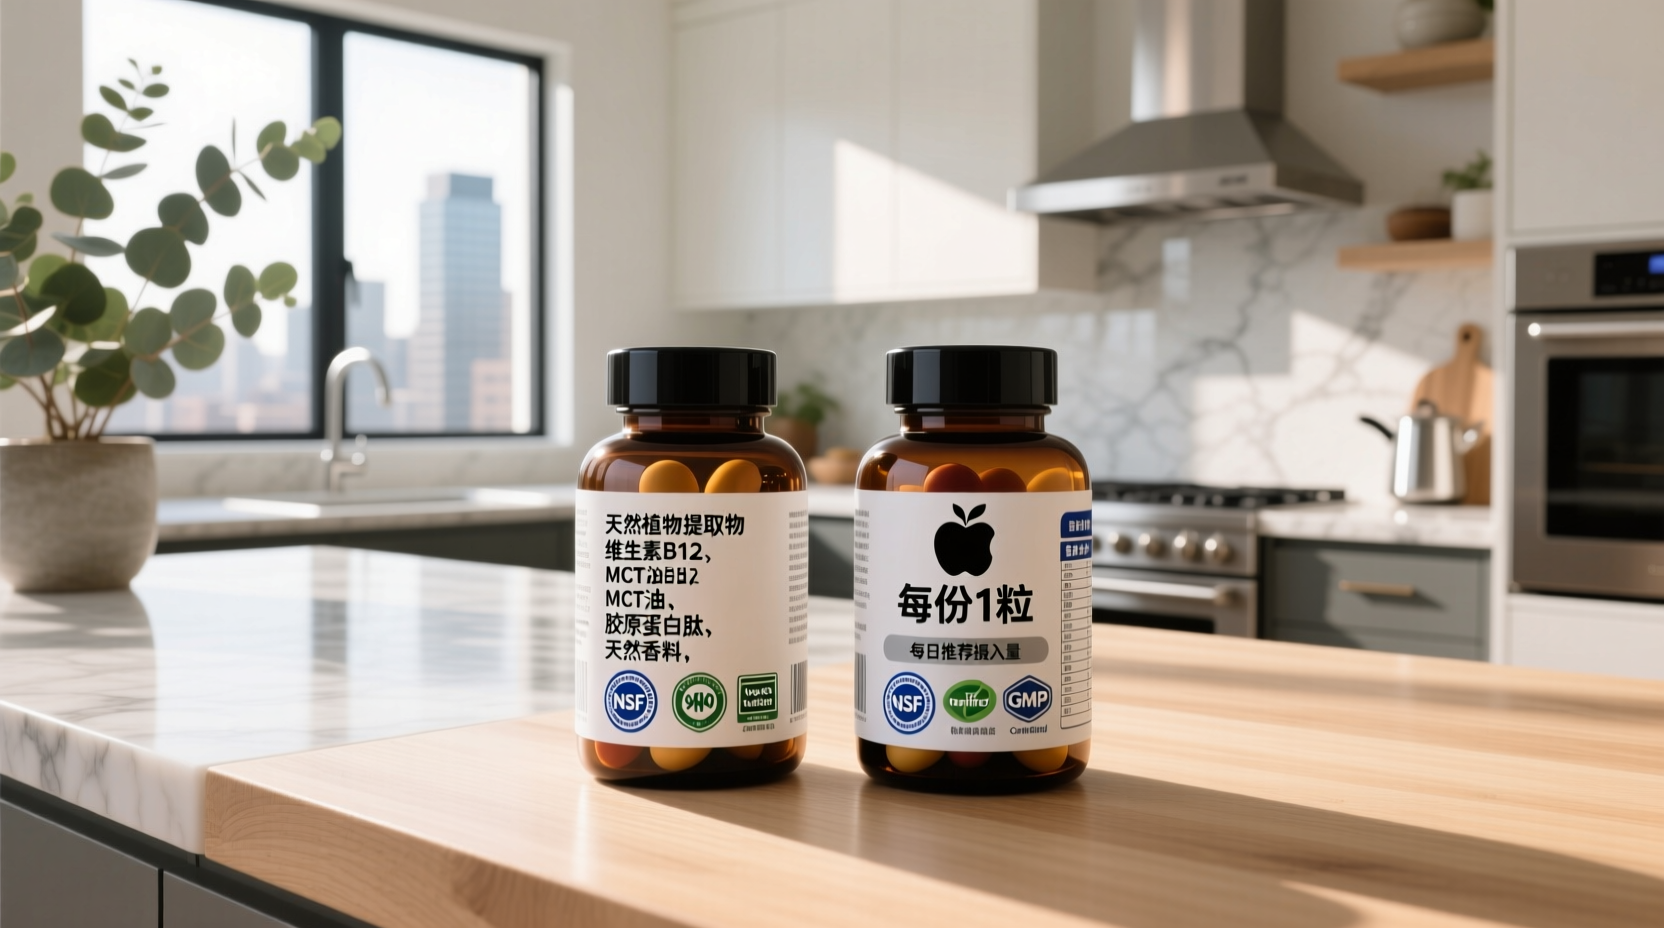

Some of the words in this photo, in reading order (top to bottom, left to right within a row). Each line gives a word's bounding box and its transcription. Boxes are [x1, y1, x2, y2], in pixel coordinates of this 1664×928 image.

[605, 513, 745, 537] 天然植物提取物
[898, 583, 1033, 625] 每份1粒
[613, 692, 646, 711] NSF
[892, 694, 923, 713] NSF
[1008, 690, 1048, 709] GMP
